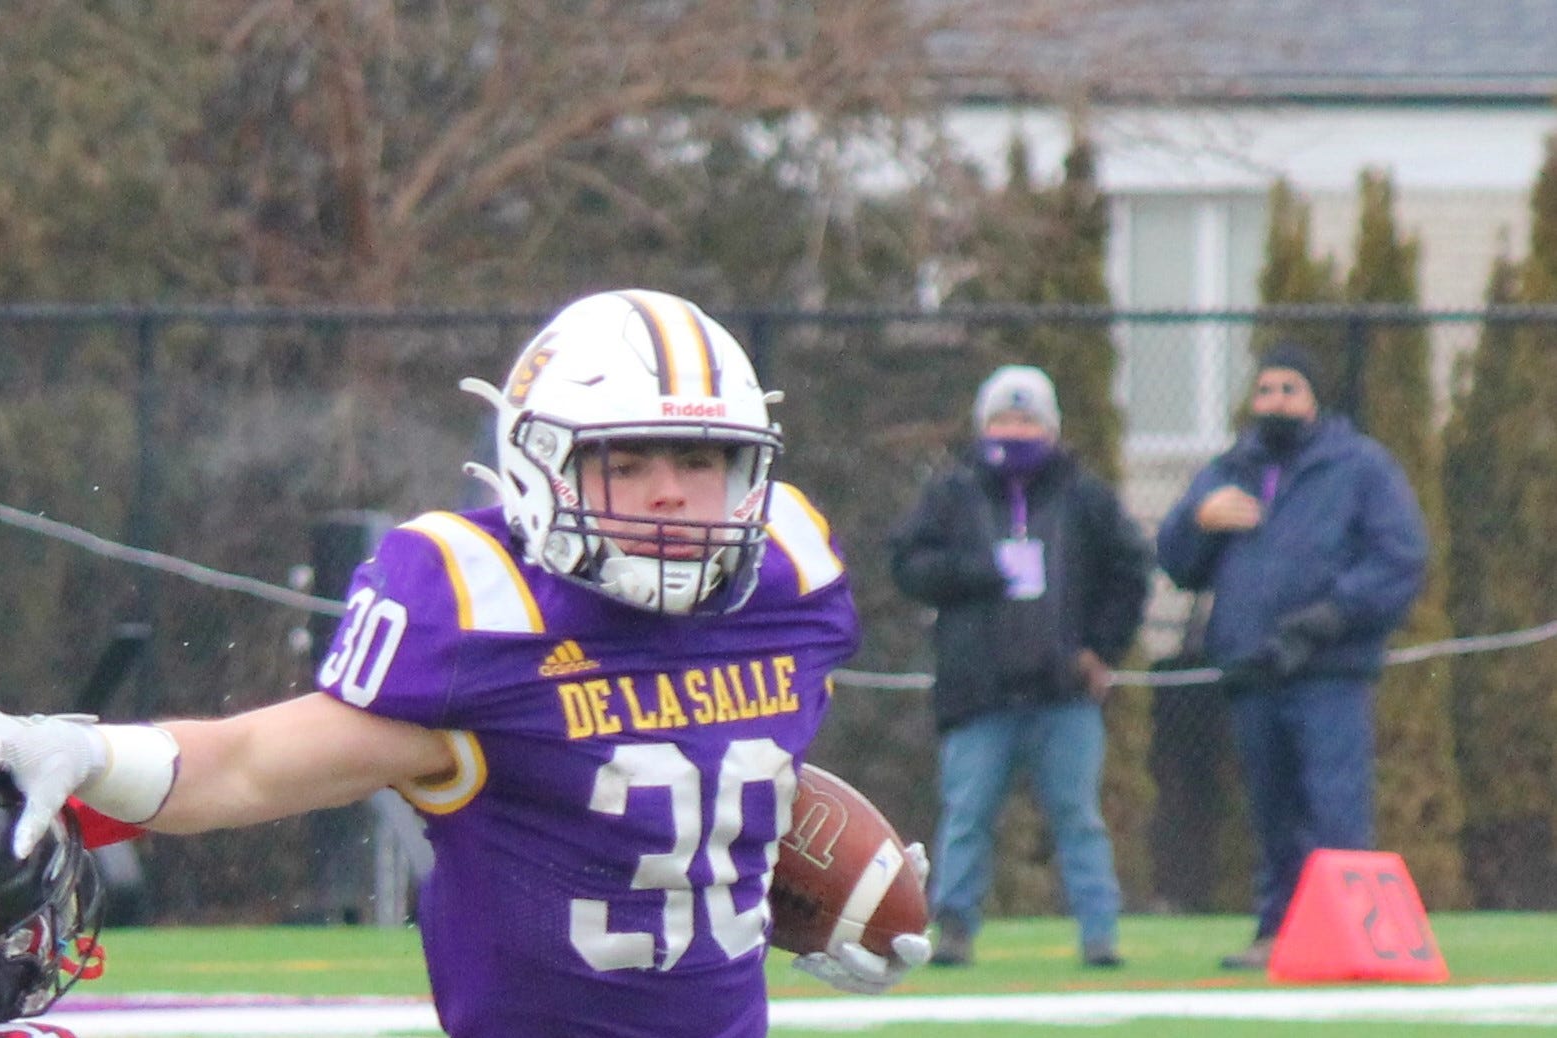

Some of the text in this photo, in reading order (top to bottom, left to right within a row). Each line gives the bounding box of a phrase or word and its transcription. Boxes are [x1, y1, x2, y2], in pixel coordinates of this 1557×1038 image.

[661, 402, 726, 417] Riddell
[319, 587, 408, 708] 30
[557, 655, 800, 740] DE LA SALLE
[569, 738, 798, 973] 30
